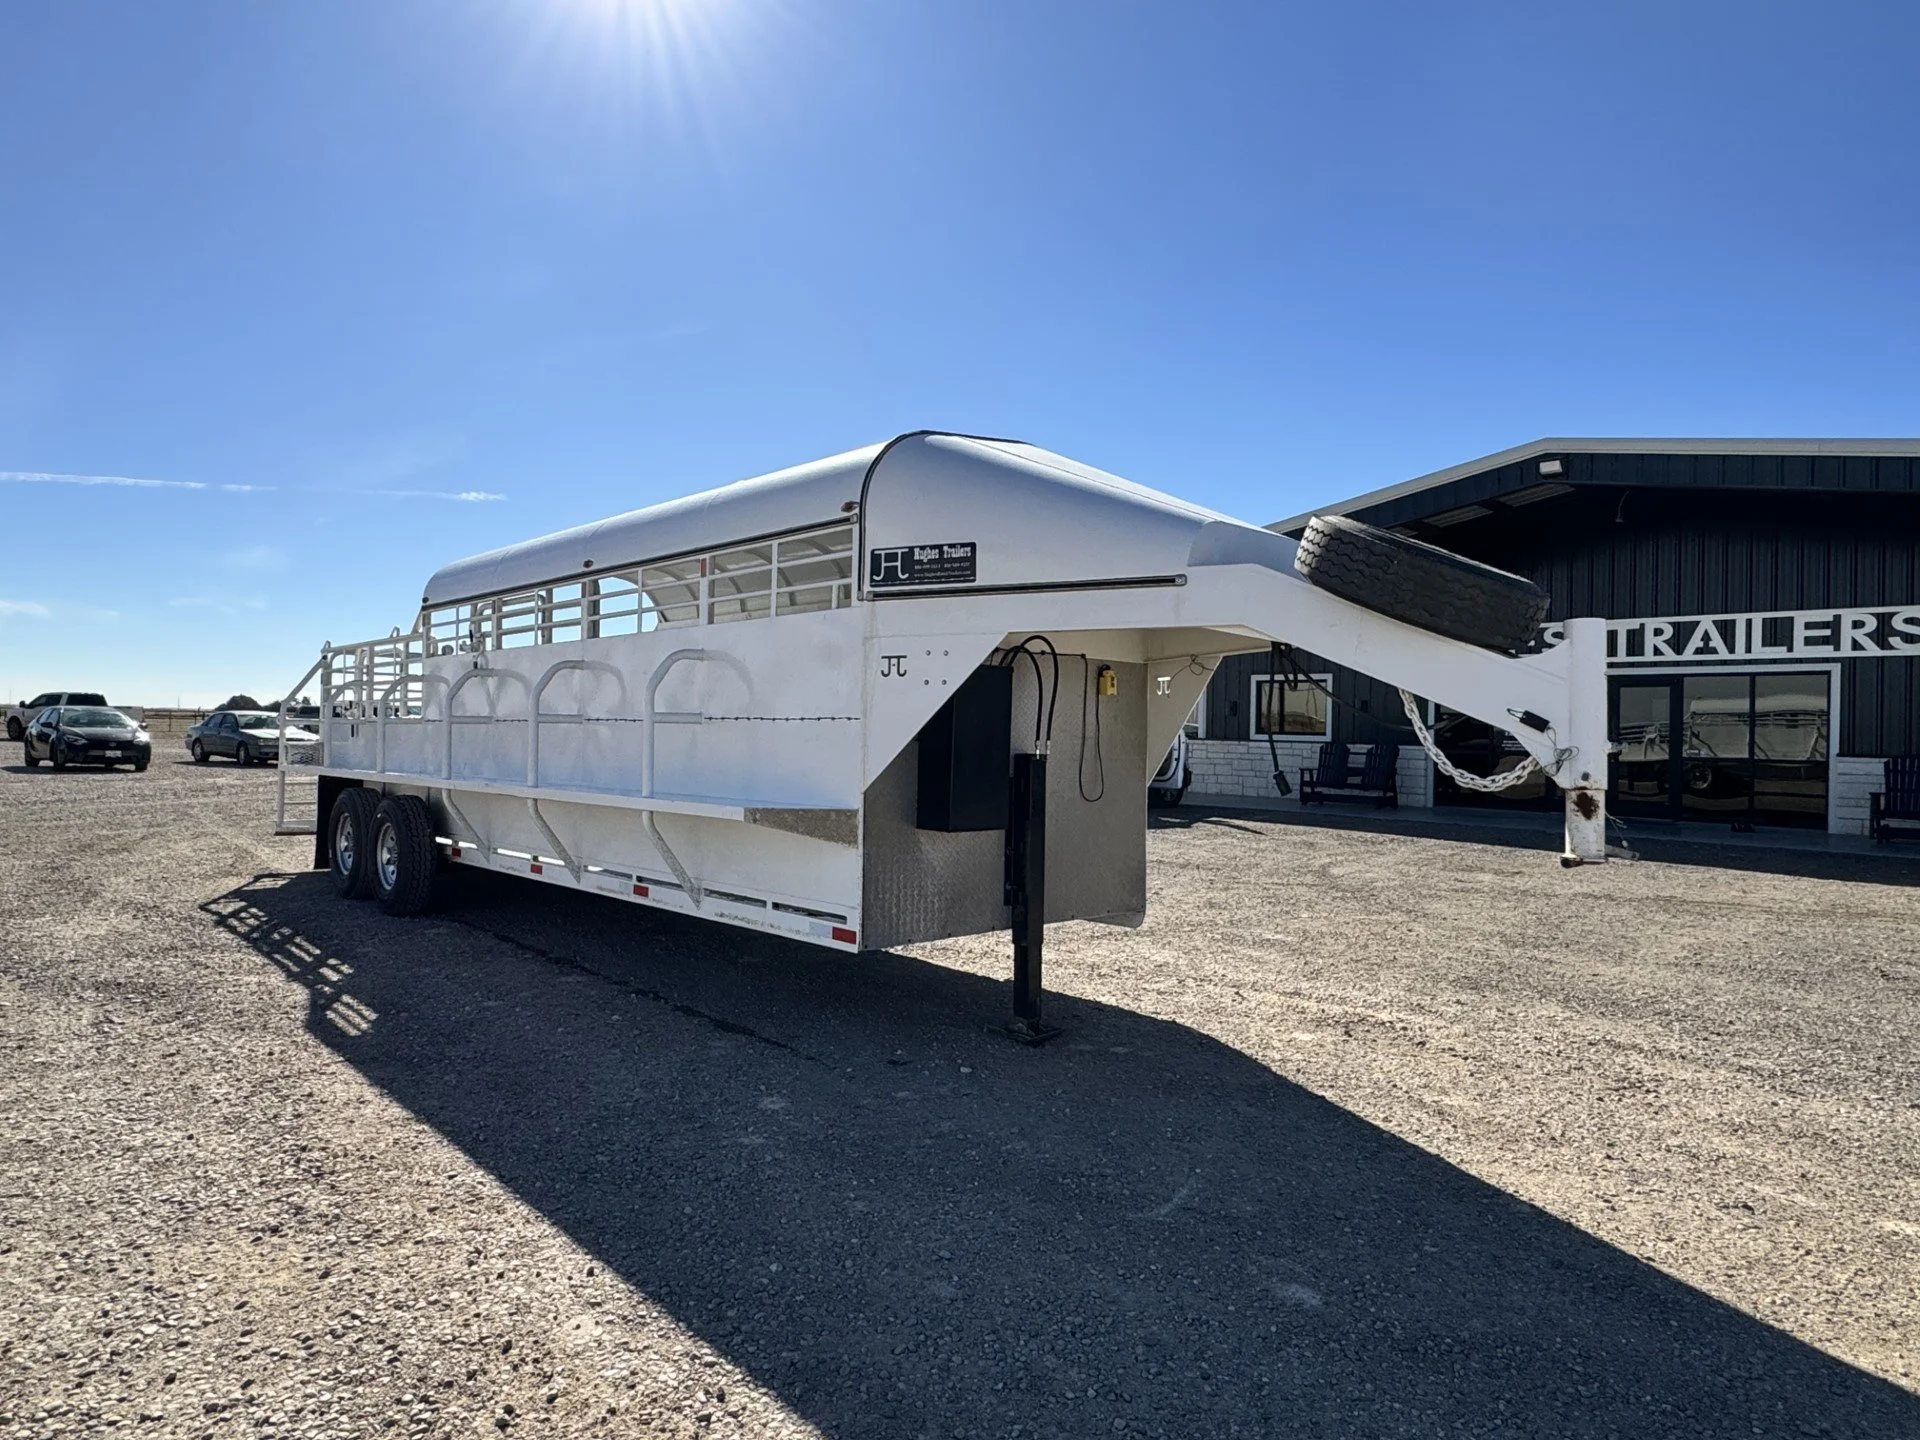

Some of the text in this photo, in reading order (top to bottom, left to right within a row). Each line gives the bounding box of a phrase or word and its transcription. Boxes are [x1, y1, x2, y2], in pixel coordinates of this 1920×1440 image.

[914, 545, 971, 562] Hughes Trailers
[1606, 611, 1920, 658] TRAILERS
